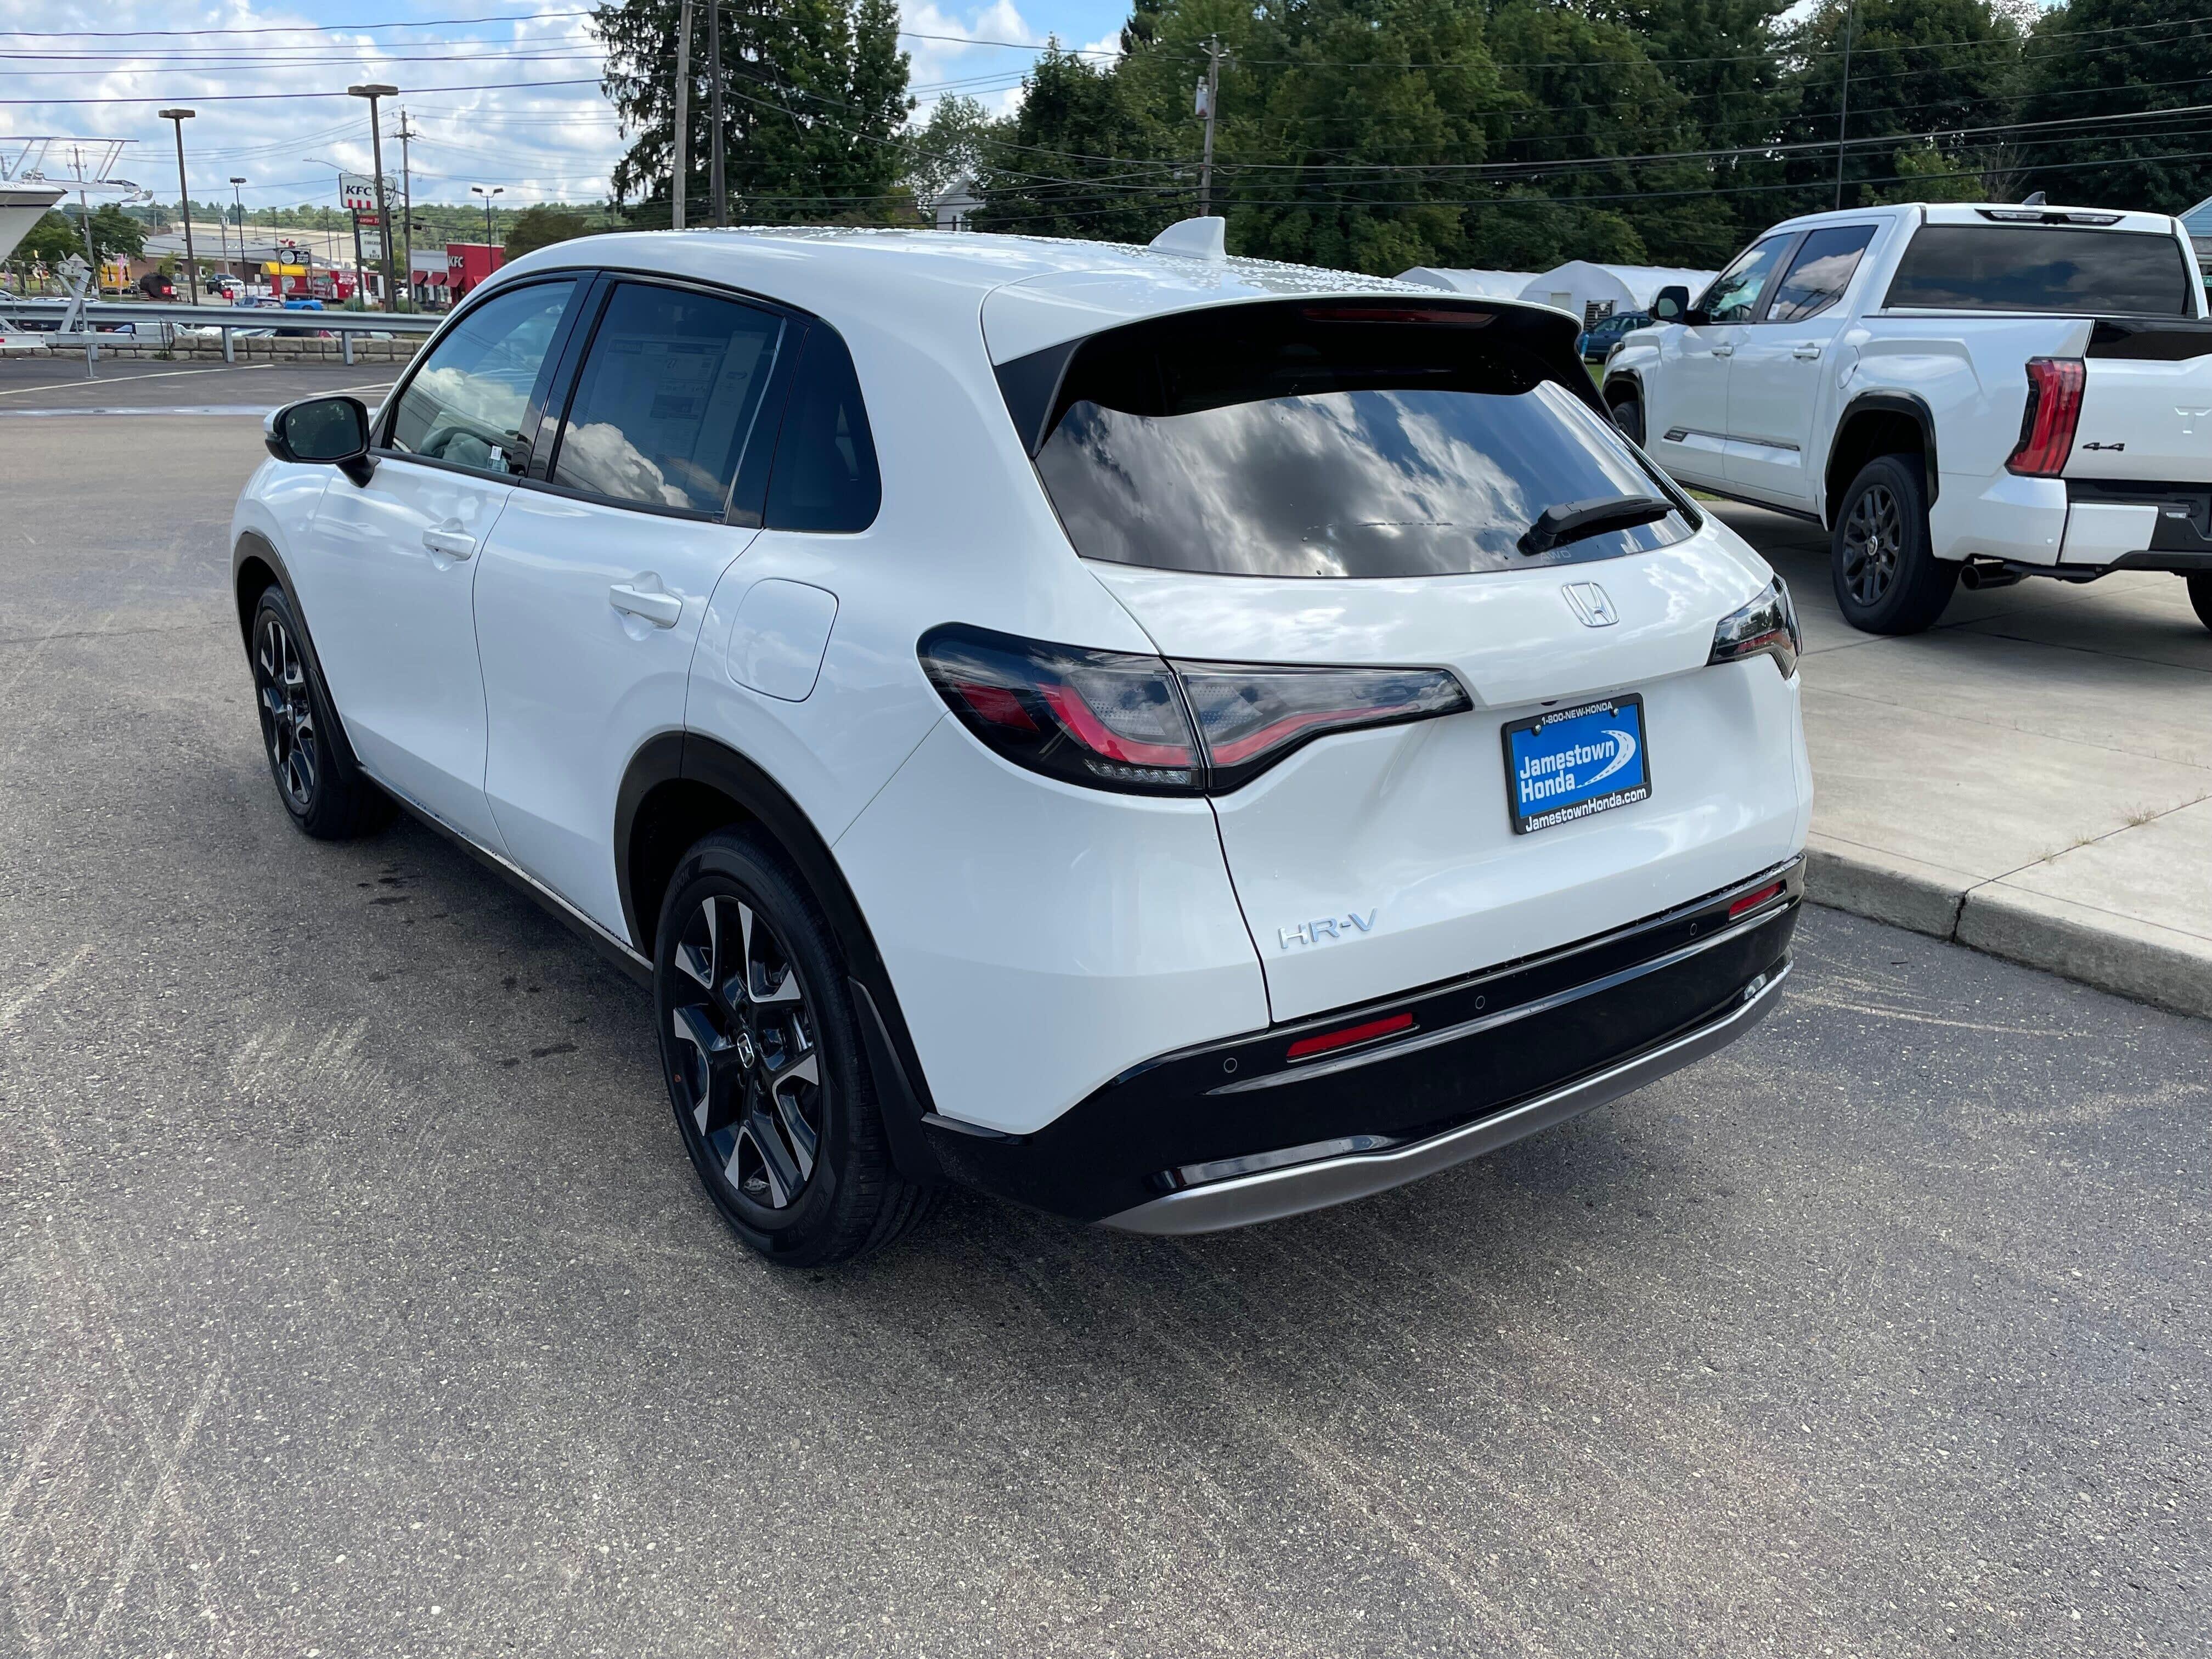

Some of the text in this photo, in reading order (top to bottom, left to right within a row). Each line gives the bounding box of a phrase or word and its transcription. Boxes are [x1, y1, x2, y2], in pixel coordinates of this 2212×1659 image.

[346, 185, 372, 196] KFC
[448, 256, 464, 268] KFC
[1541, 550, 1571, 561] AWD
[1541, 701, 1613, 725] 1-800-NEW-HONDA
[1520, 740, 1615, 780] Jamestown
[1520, 770, 1576, 803] Honda
[1526, 788, 1646, 832] JamestownHonda.com
[1278, 907, 1378, 949] HR-V
